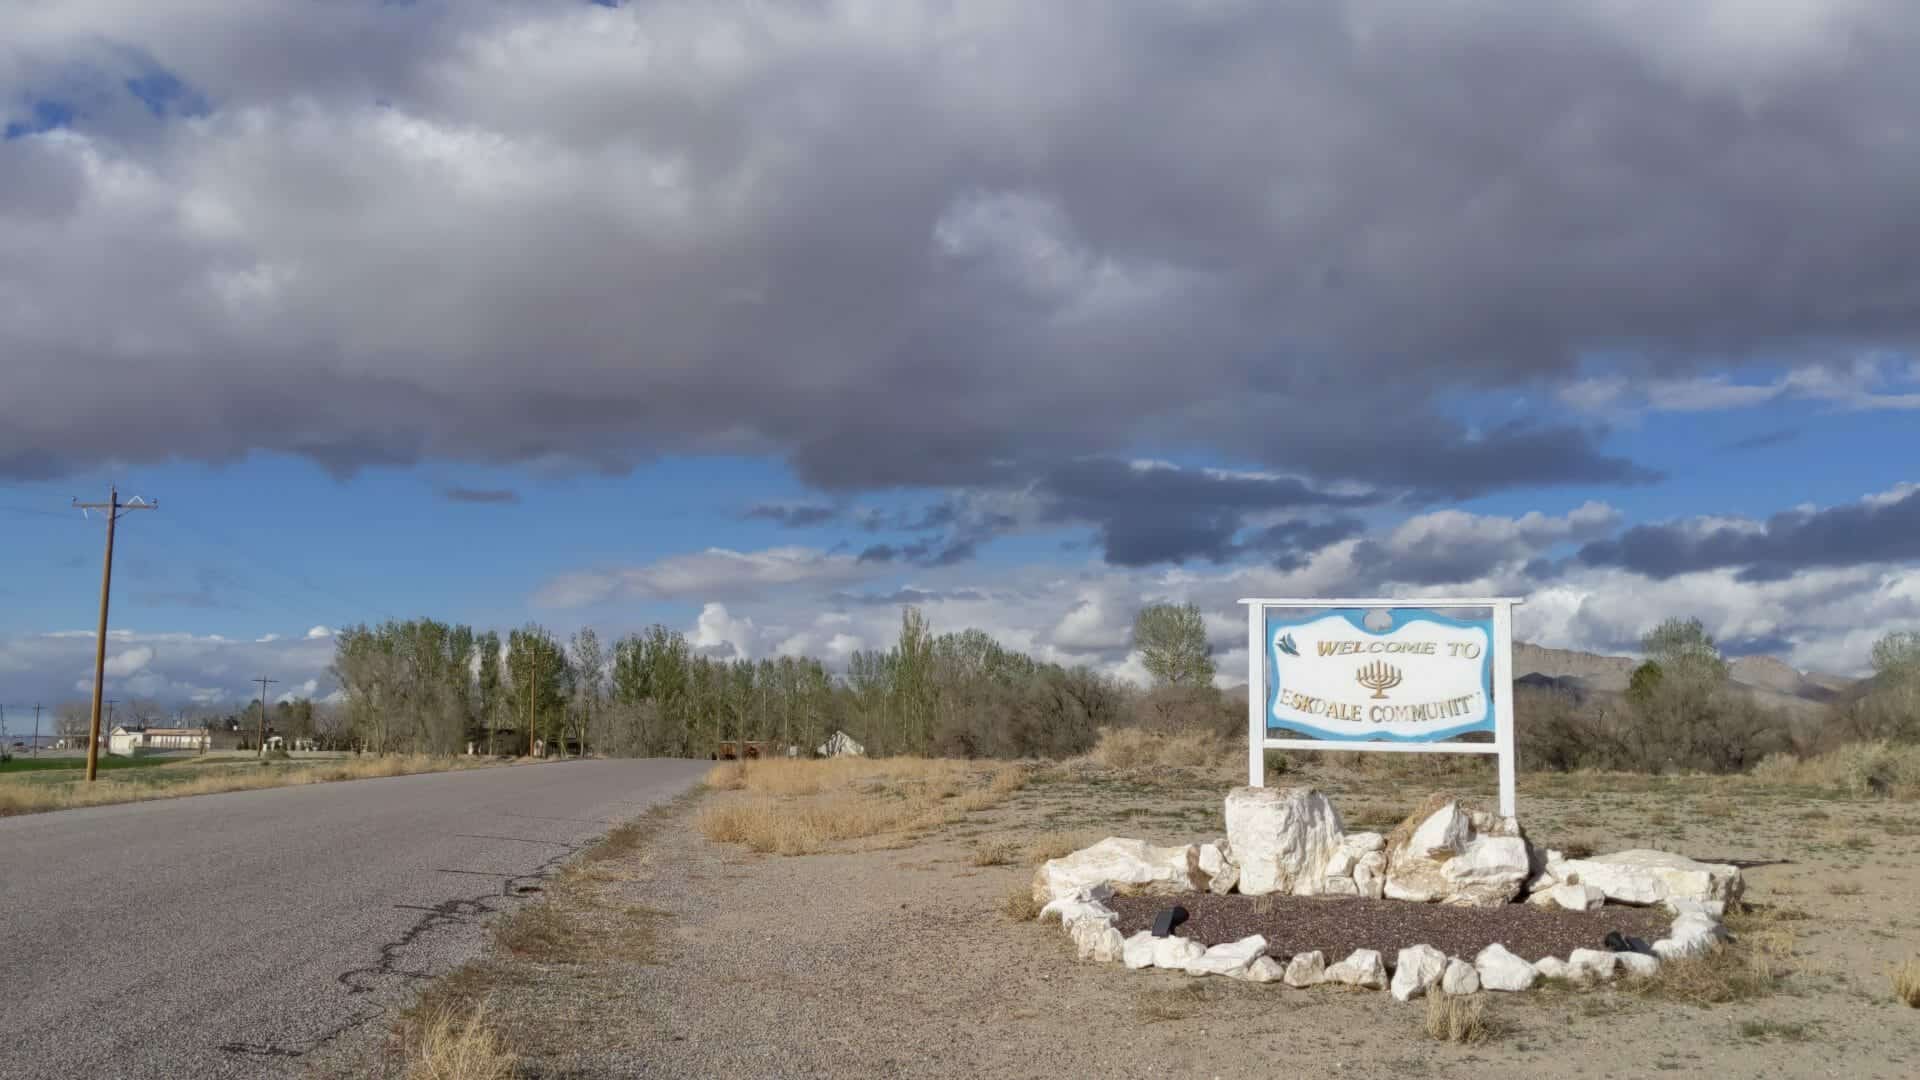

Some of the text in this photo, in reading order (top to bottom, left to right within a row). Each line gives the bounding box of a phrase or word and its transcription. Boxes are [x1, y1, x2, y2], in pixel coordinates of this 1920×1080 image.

[1317, 640, 1481, 660] WELCOME TO
[1280, 688, 1481, 723] ESKDALE COMMUNIT
